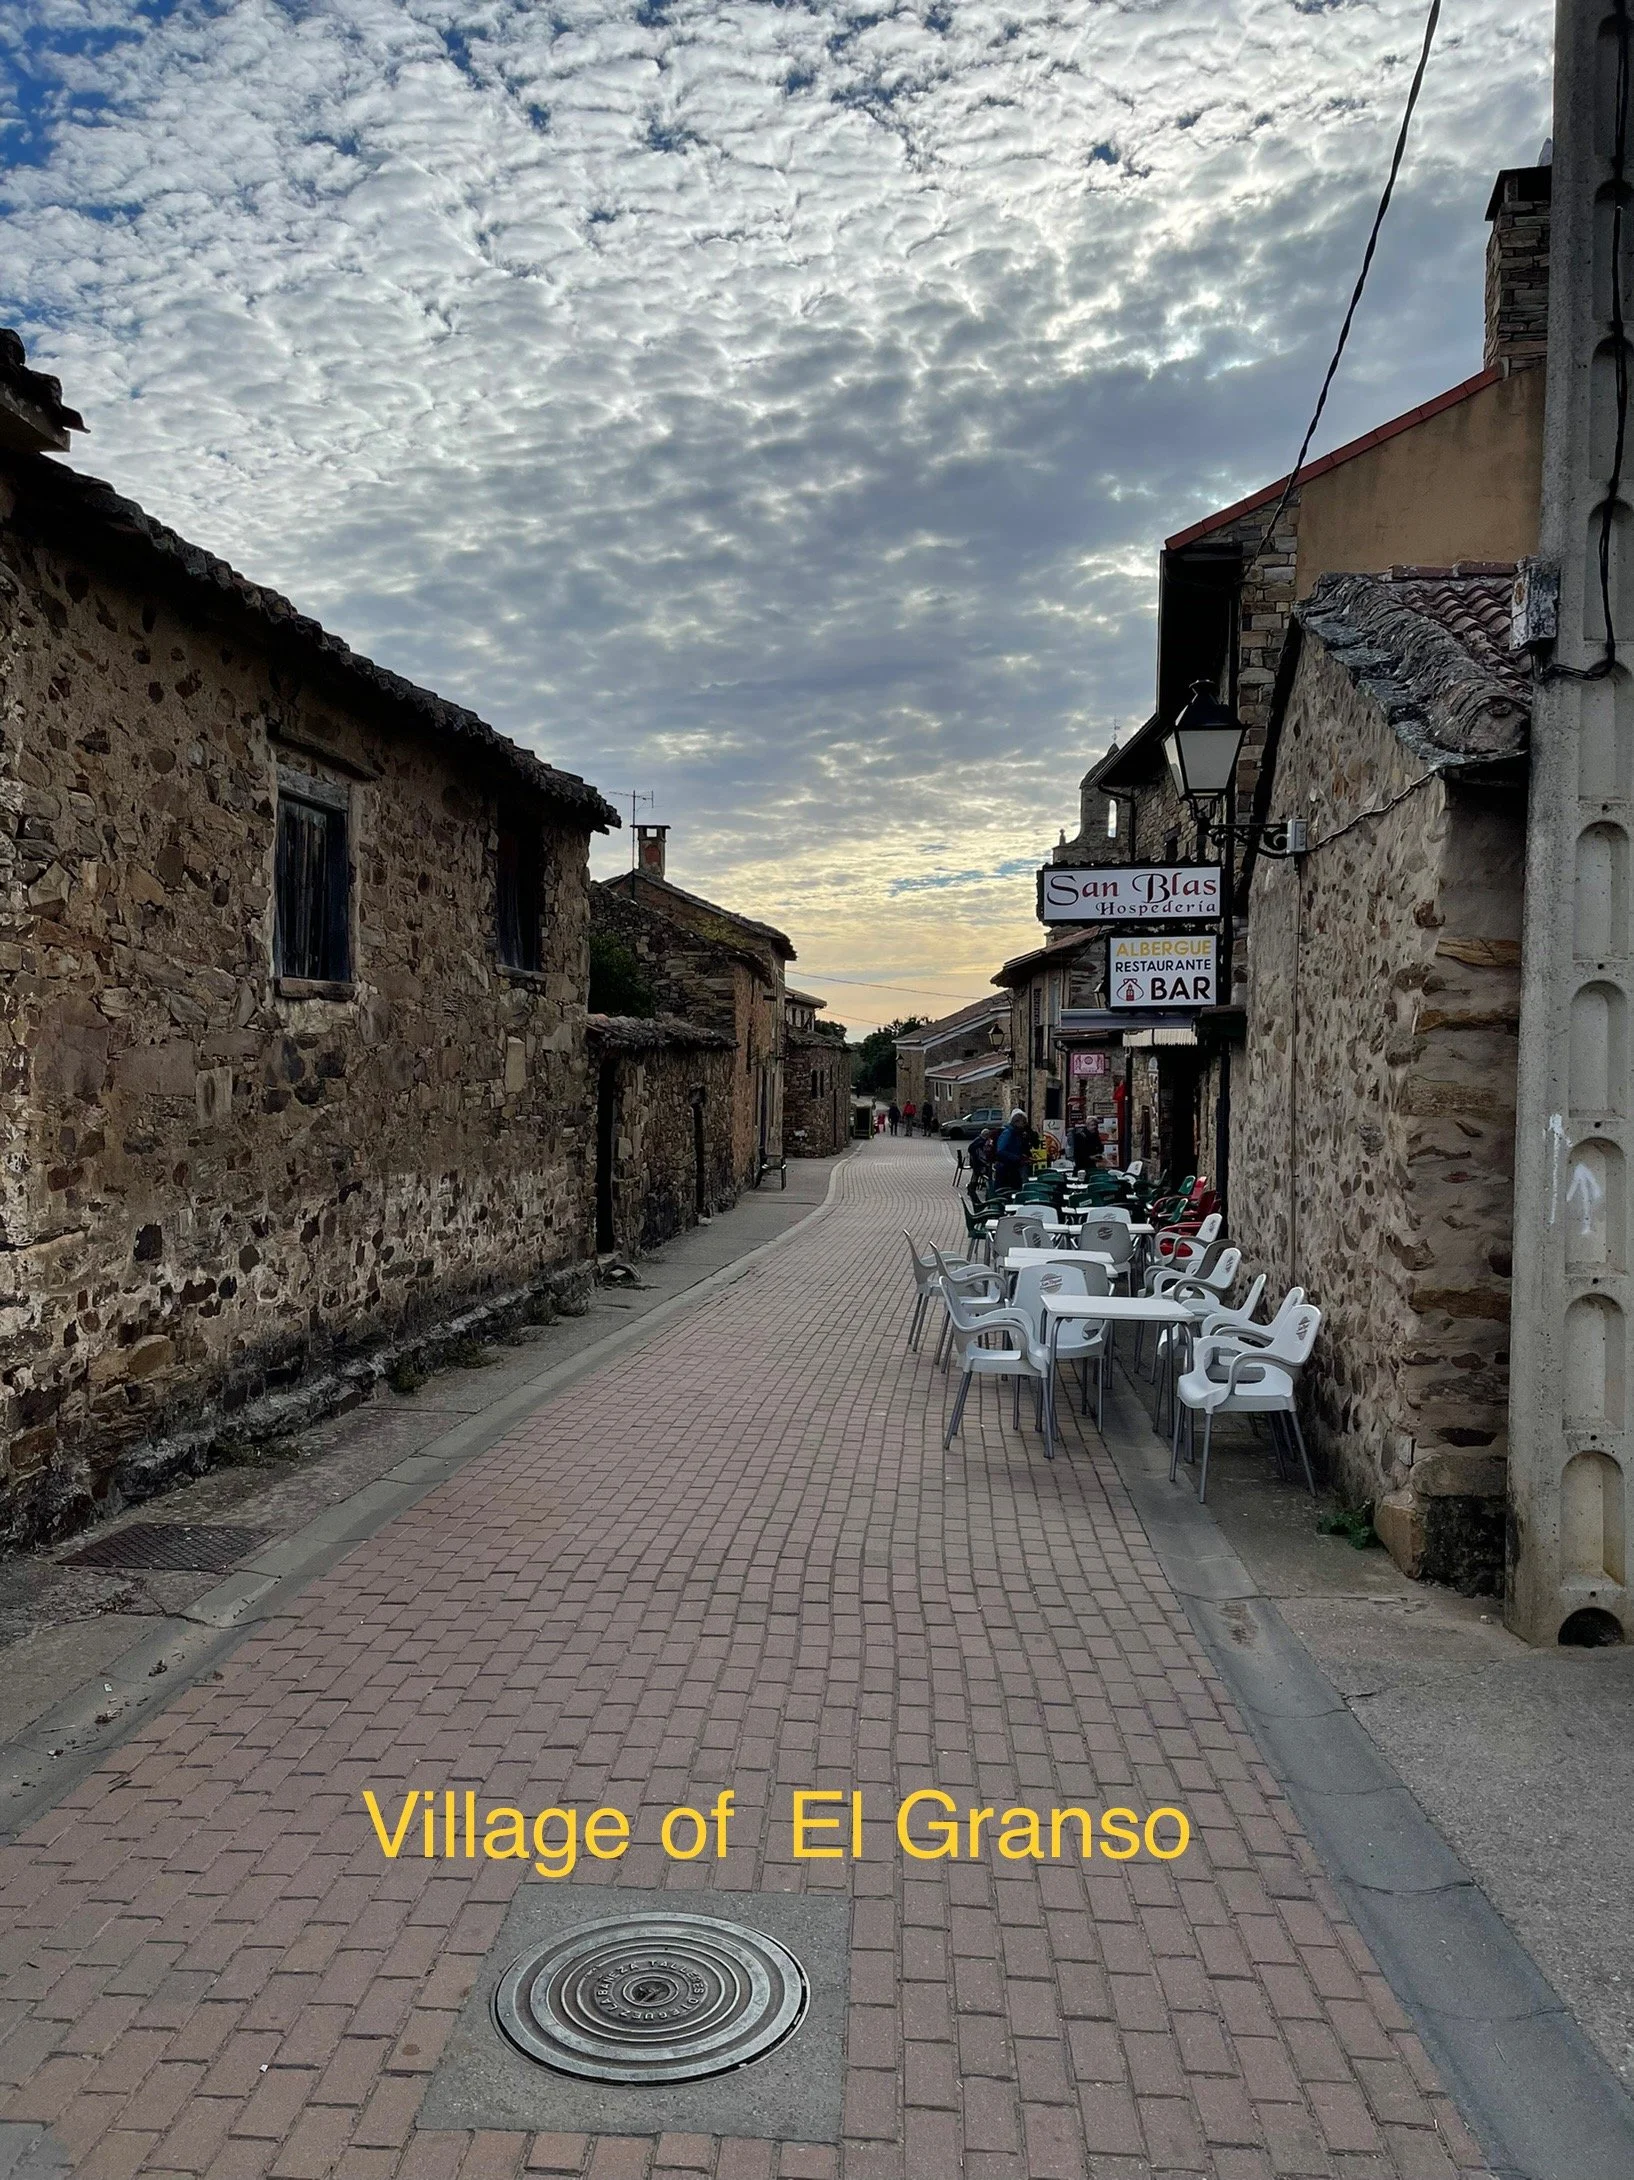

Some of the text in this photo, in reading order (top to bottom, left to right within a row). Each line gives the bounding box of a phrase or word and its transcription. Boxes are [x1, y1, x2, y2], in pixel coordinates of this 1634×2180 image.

[1047, 872, 1217, 906] San Blas
[1116, 940, 1212, 957] ALBERGUE
[1115, 959, 1212, 973] RESTAURANTE
[1150, 976, 1211, 1001] BAR
[648, 1960, 705, 1994] TALLERES
